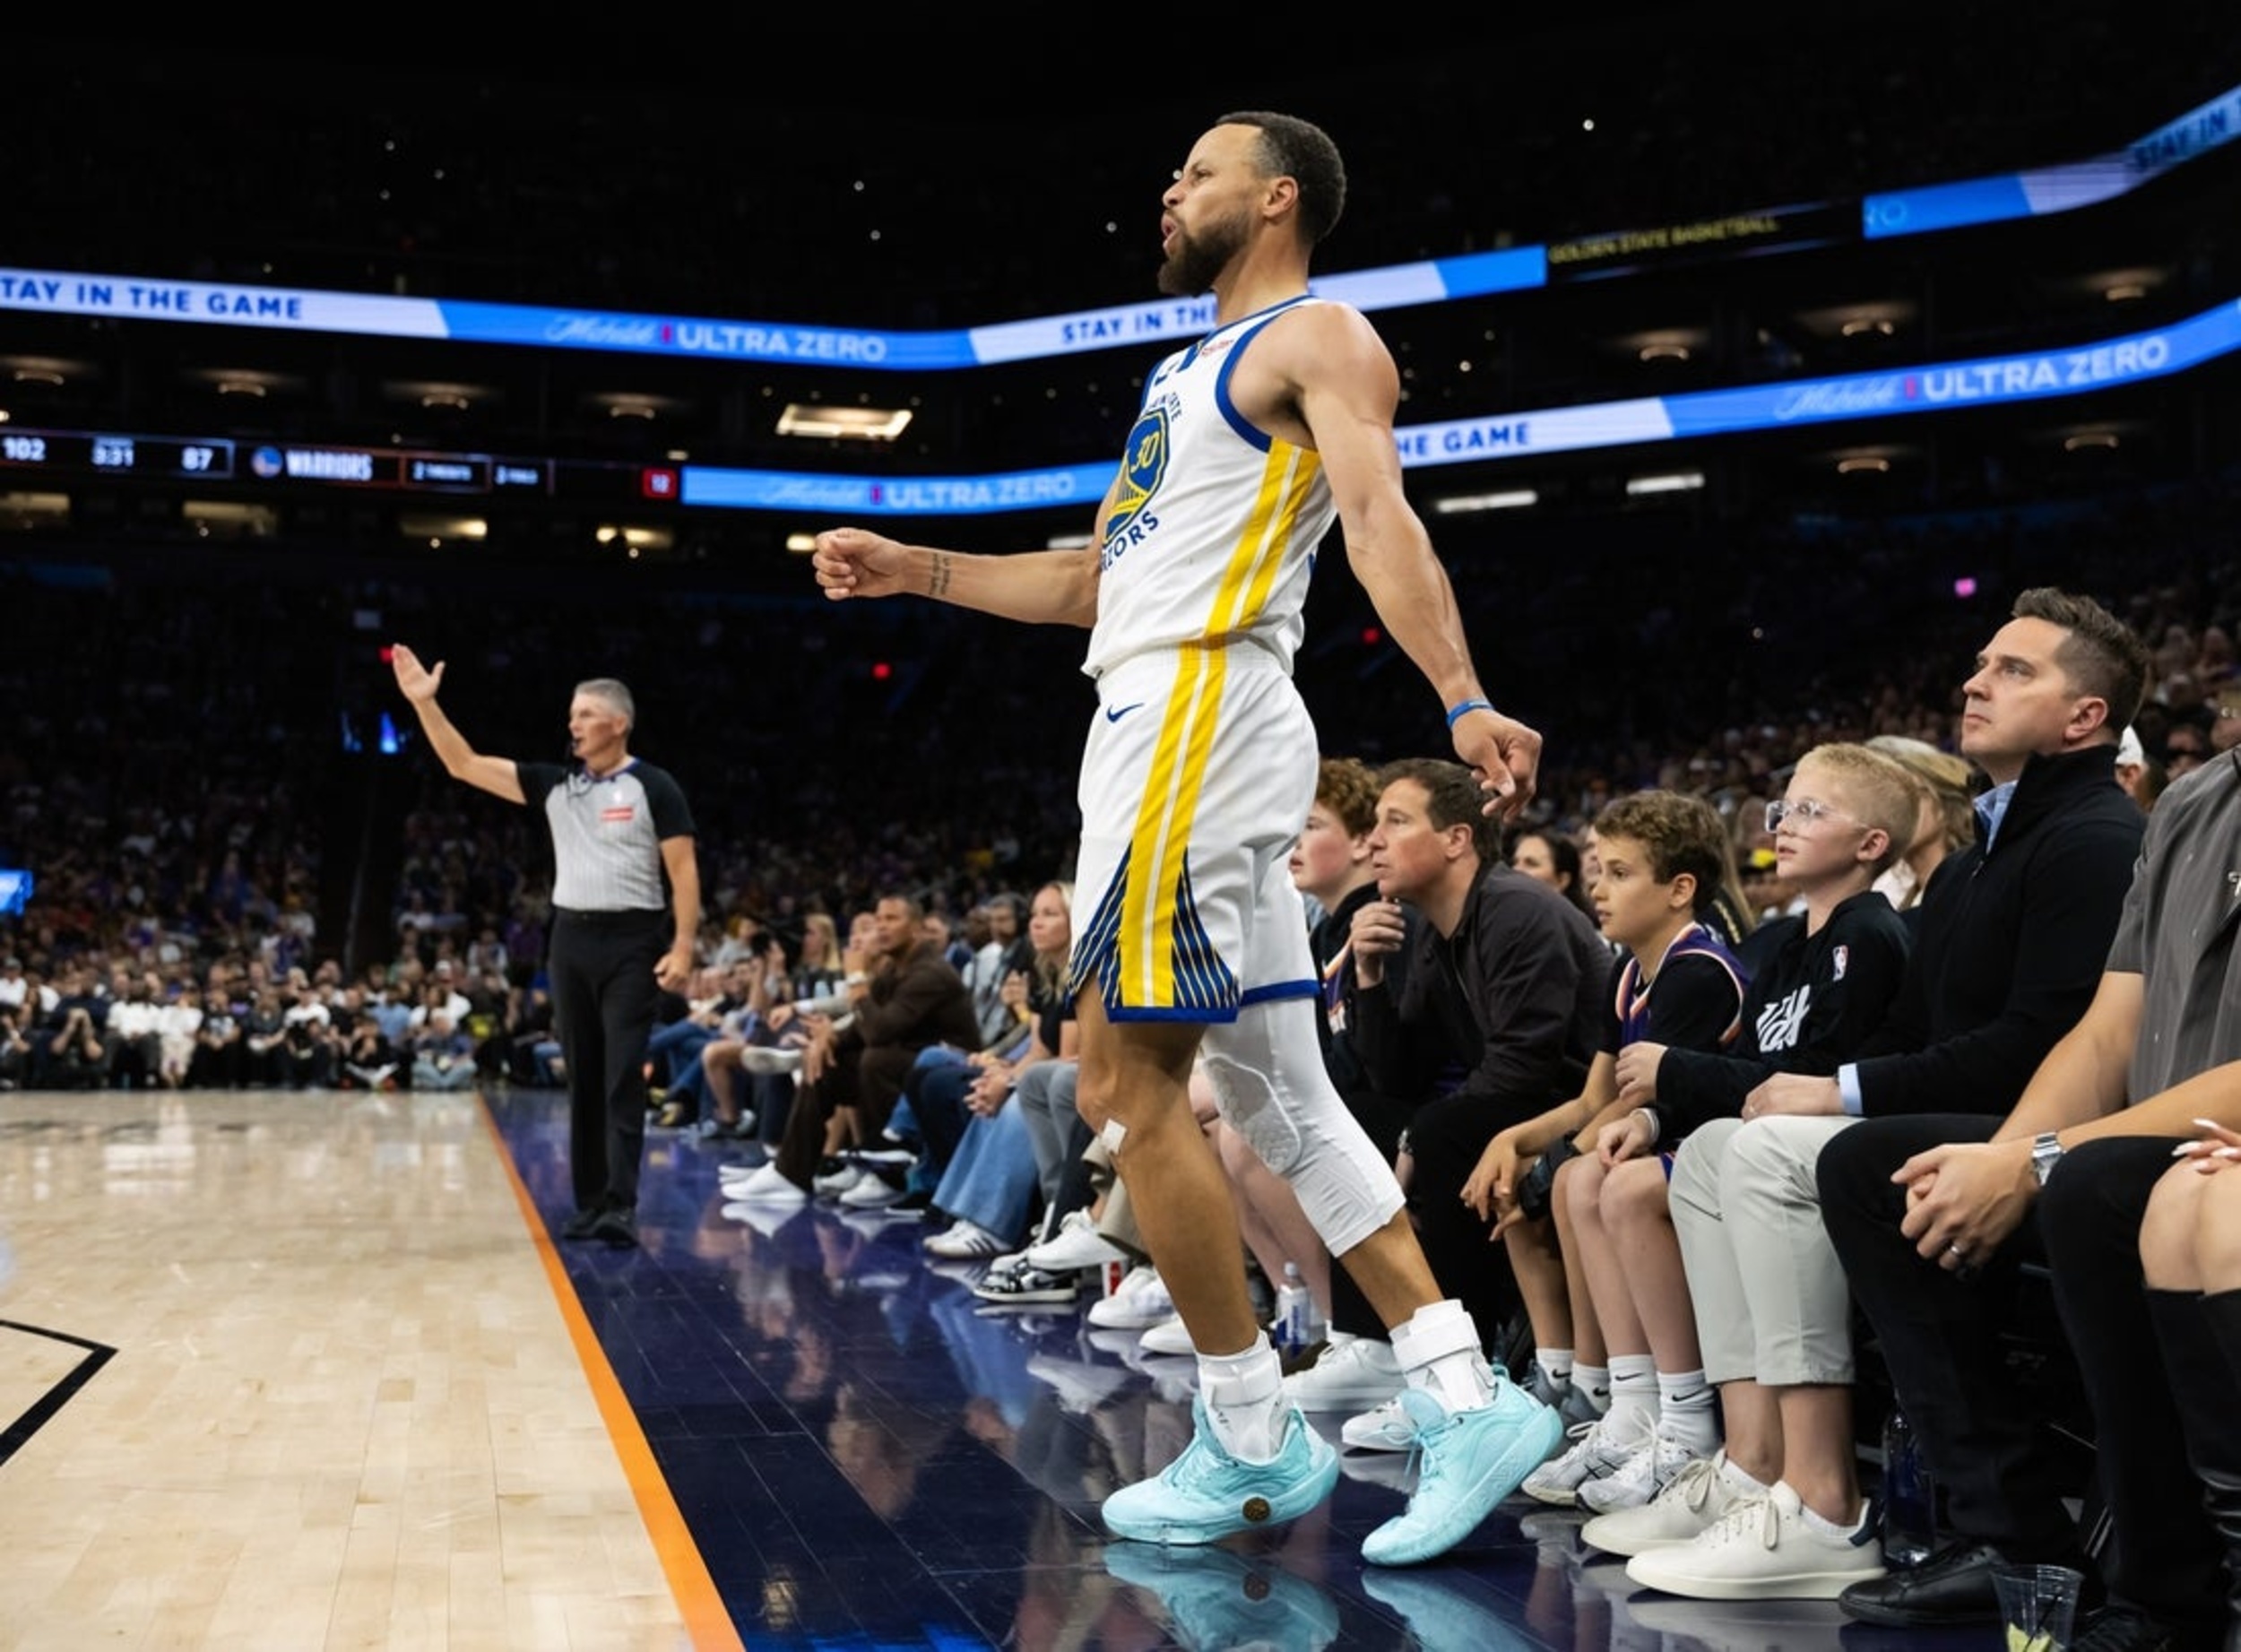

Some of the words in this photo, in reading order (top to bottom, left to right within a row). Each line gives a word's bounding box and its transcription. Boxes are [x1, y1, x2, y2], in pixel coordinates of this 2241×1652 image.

[2134, 125, 2190, 174] STAY
[2199, 107, 2227, 145] IN
[76, 282, 112, 306] IN
[129, 287, 191, 312] THE
[206, 292, 303, 320] GAME
[677, 322, 787, 355] ULTRA
[794, 335, 887, 362] ZERO
[1062, 318, 1122, 343] STAY
[1135, 311, 1162, 333] IN
[1923, 359, 2059, 401] ULTRA
[2065, 335, 2168, 386] ZERO
[3, 437, 46, 462] 102
[1130, 430, 1161, 473] 30
[1444, 422, 1529, 453] GAME
[181, 447, 213, 471] 87
[285, 450, 373, 481] WARRIORS
[887, 481, 991, 510] ULTRA
[995, 471, 1074, 503] ZERO
